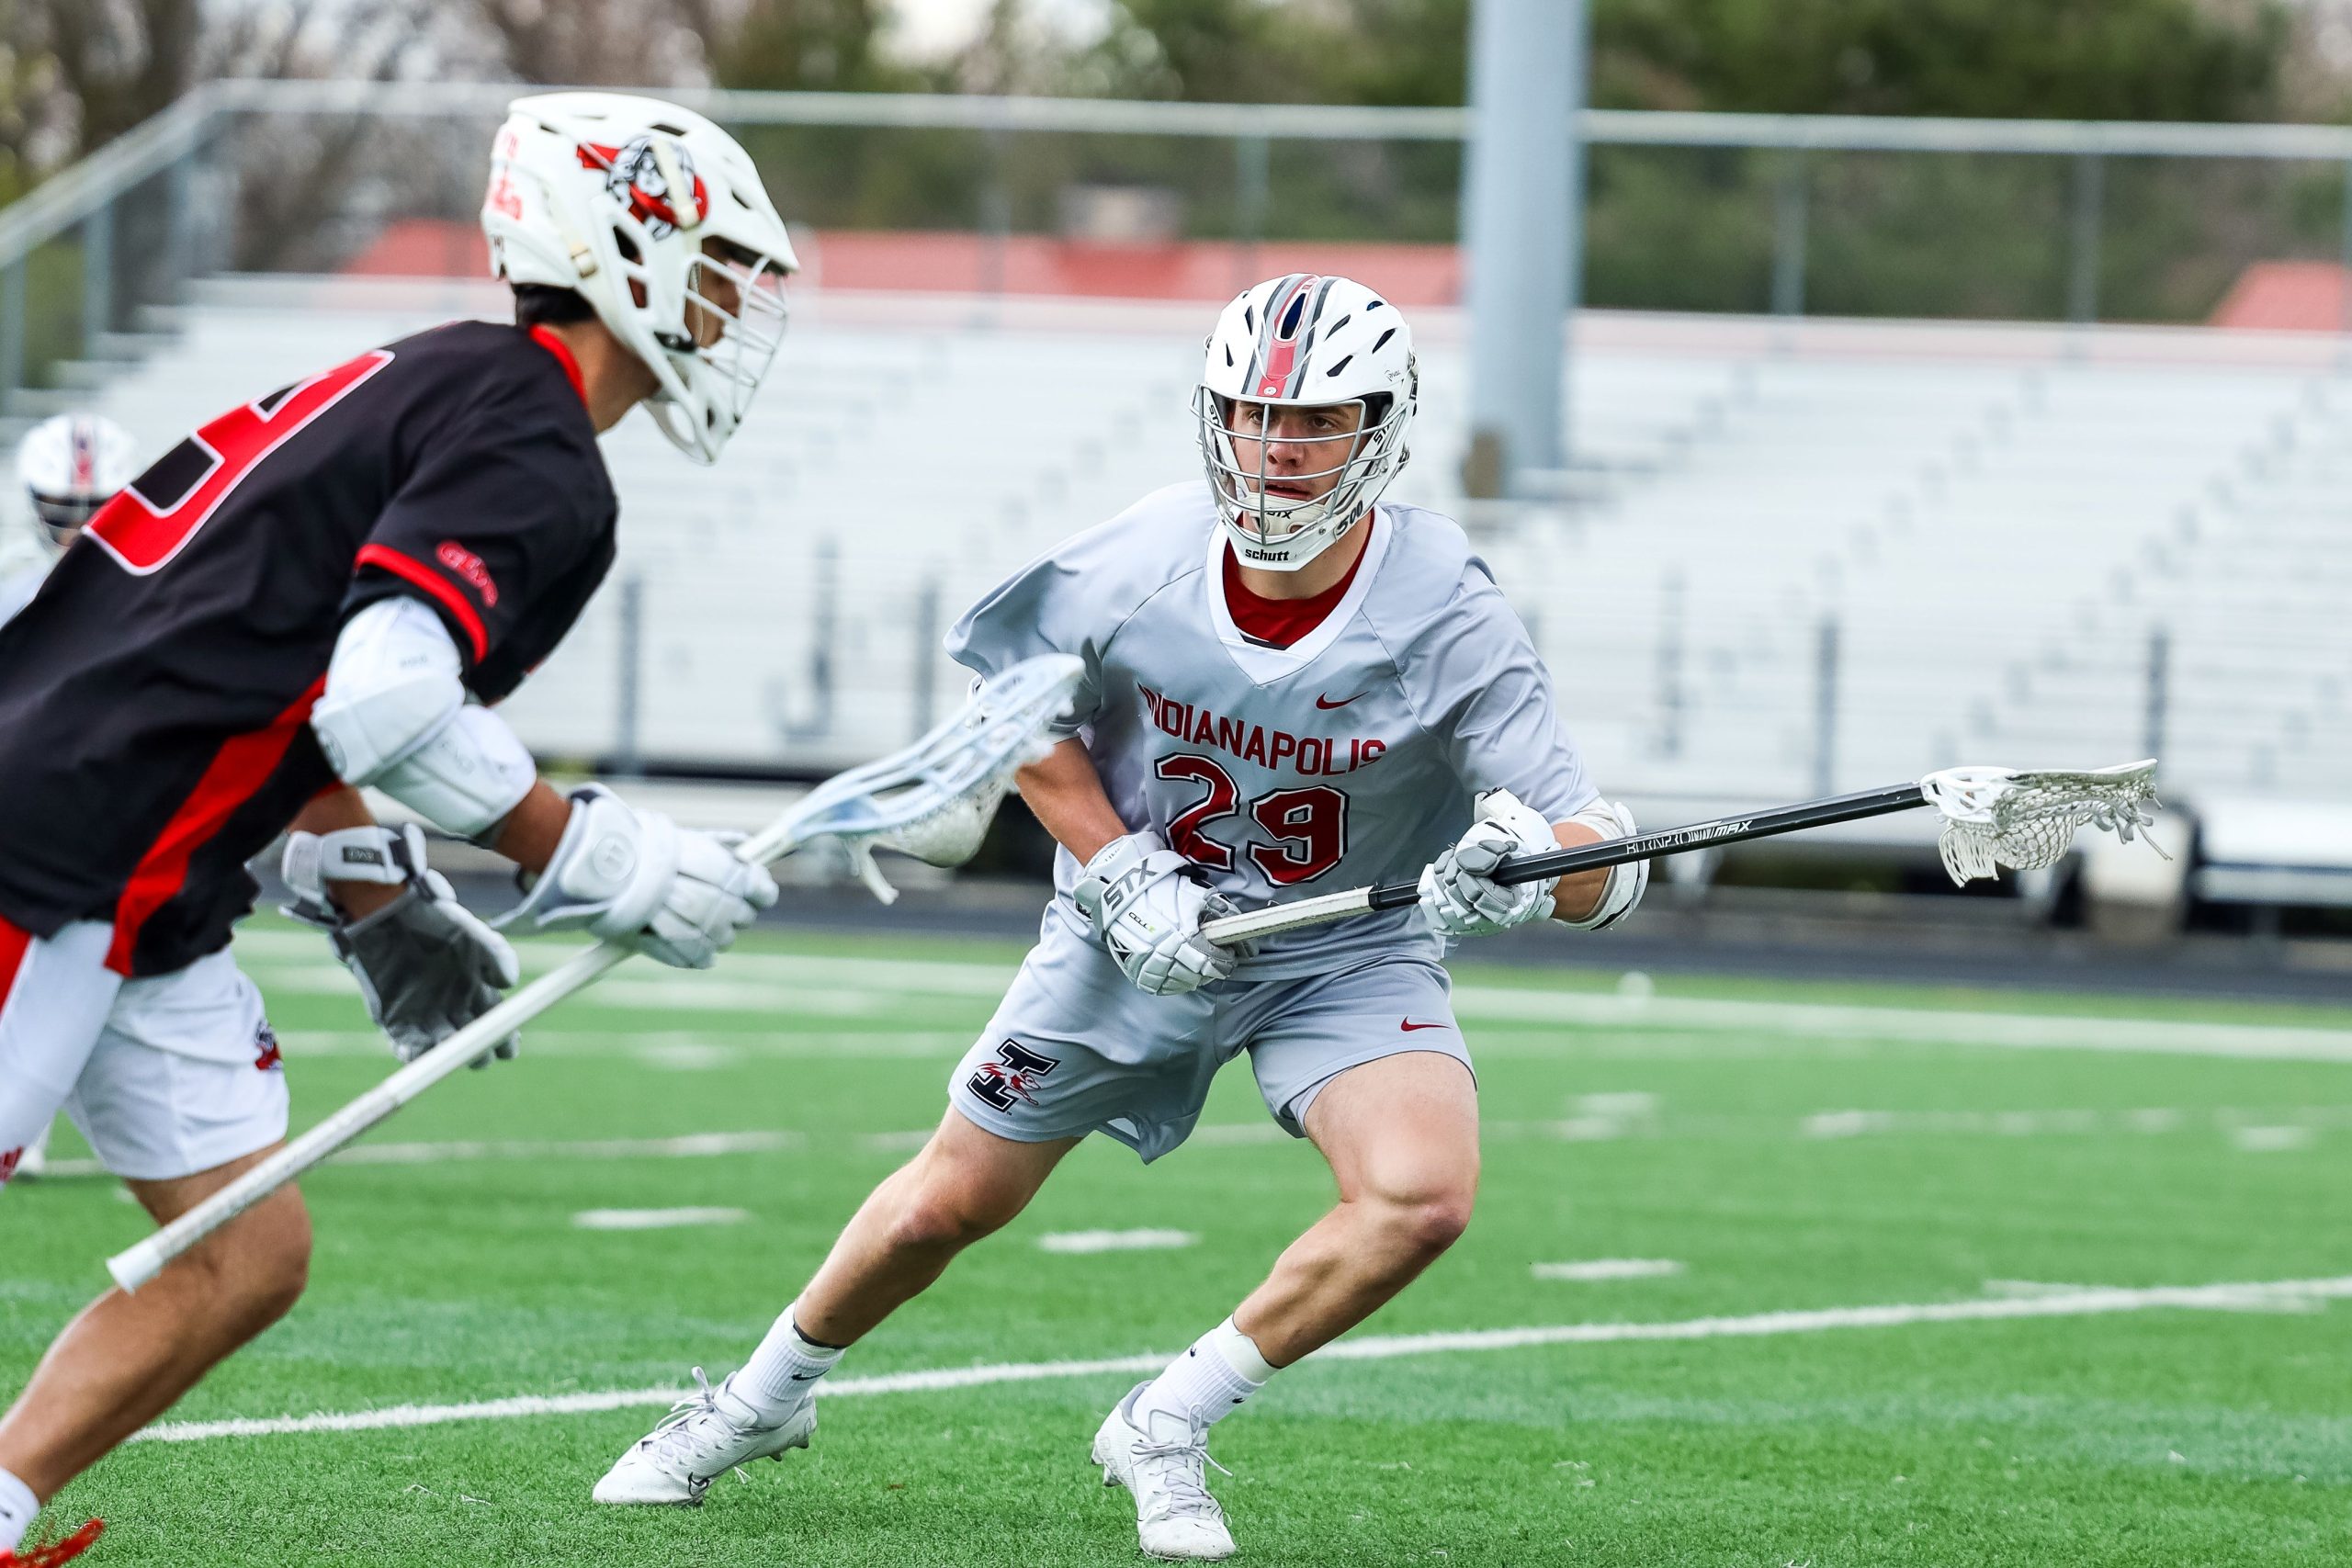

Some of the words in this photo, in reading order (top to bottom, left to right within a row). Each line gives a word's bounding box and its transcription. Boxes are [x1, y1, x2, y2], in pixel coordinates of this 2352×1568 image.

[1245, 548, 1290, 561] schutt
[1154, 751, 1351, 888] 29
[1103, 858, 1159, 912] STX
